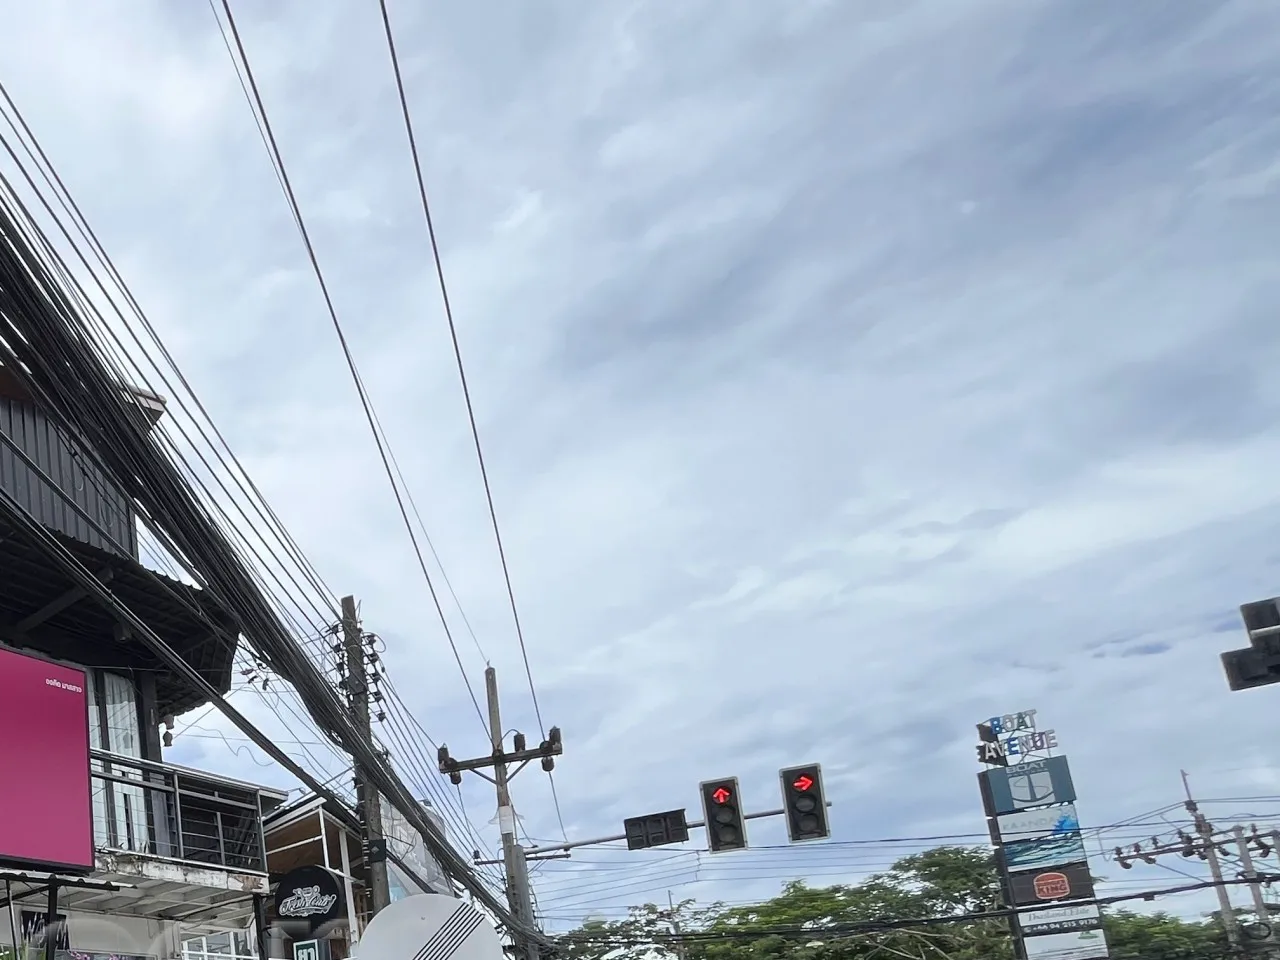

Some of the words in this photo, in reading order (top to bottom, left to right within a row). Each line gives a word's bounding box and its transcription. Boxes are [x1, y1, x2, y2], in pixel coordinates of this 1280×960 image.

[990, 708, 1037, 734] BOAT
[984, 729, 1058, 760] AVENUE
[1006, 760, 1048, 774] BOAT
